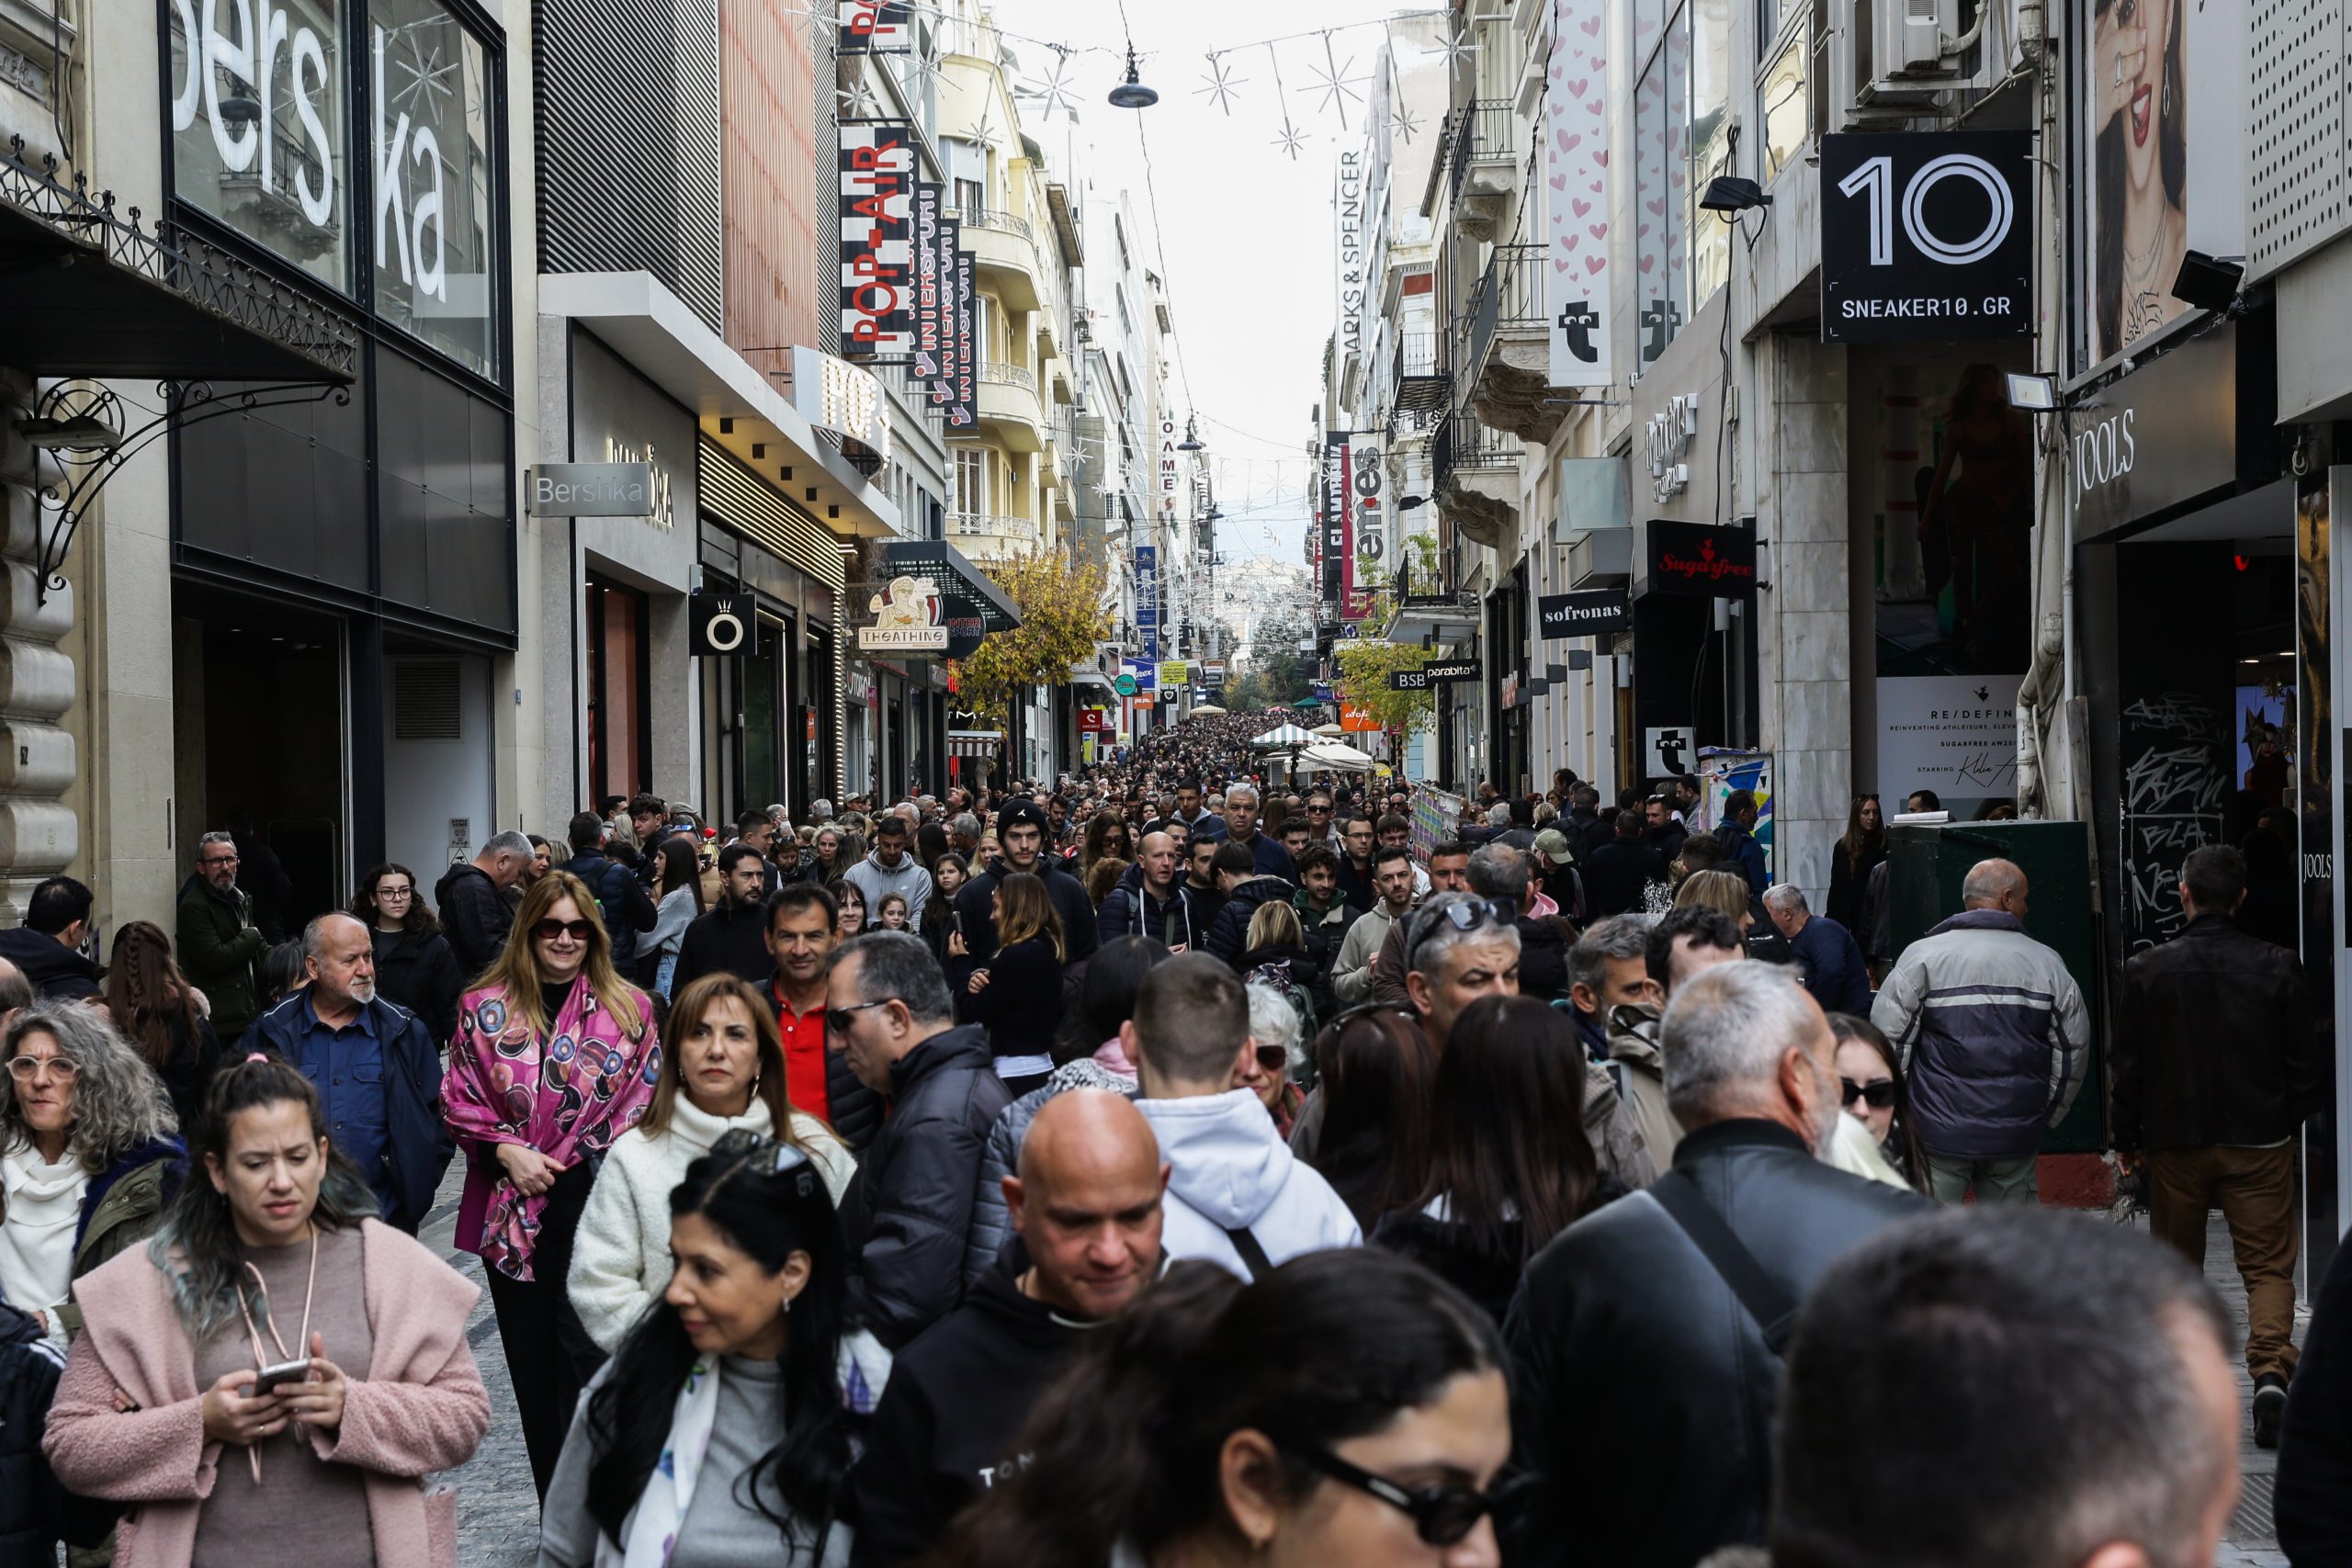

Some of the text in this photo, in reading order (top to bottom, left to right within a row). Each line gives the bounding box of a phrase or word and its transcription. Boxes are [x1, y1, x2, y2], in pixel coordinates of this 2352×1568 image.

[1341, 151, 1360, 265] SPENCER
[1838, 152, 2014, 265] 10
[853, 139, 898, 342] POP-AIR
[919, 190, 935, 351] INTERSPORT
[1343, 290, 1361, 350] ARKS
[1841, 297, 2011, 319] SNEAKER10.GR
[2075, 409, 2135, 510] JOOLS
[536, 477, 643, 502] Bershka
[1658, 554, 1754, 580] Sugarfree
[947, 617, 981, 627] INTER
[1544, 604, 1622, 623] sofronas
[948, 627, 980, 637] SPORT
[1399, 674, 1425, 687] BSB
[1427, 665, 1470, 678] parabita
[1931, 710, 2013, 719] RE/DEFIN
[2303, 853, 2332, 883] JOOLS
